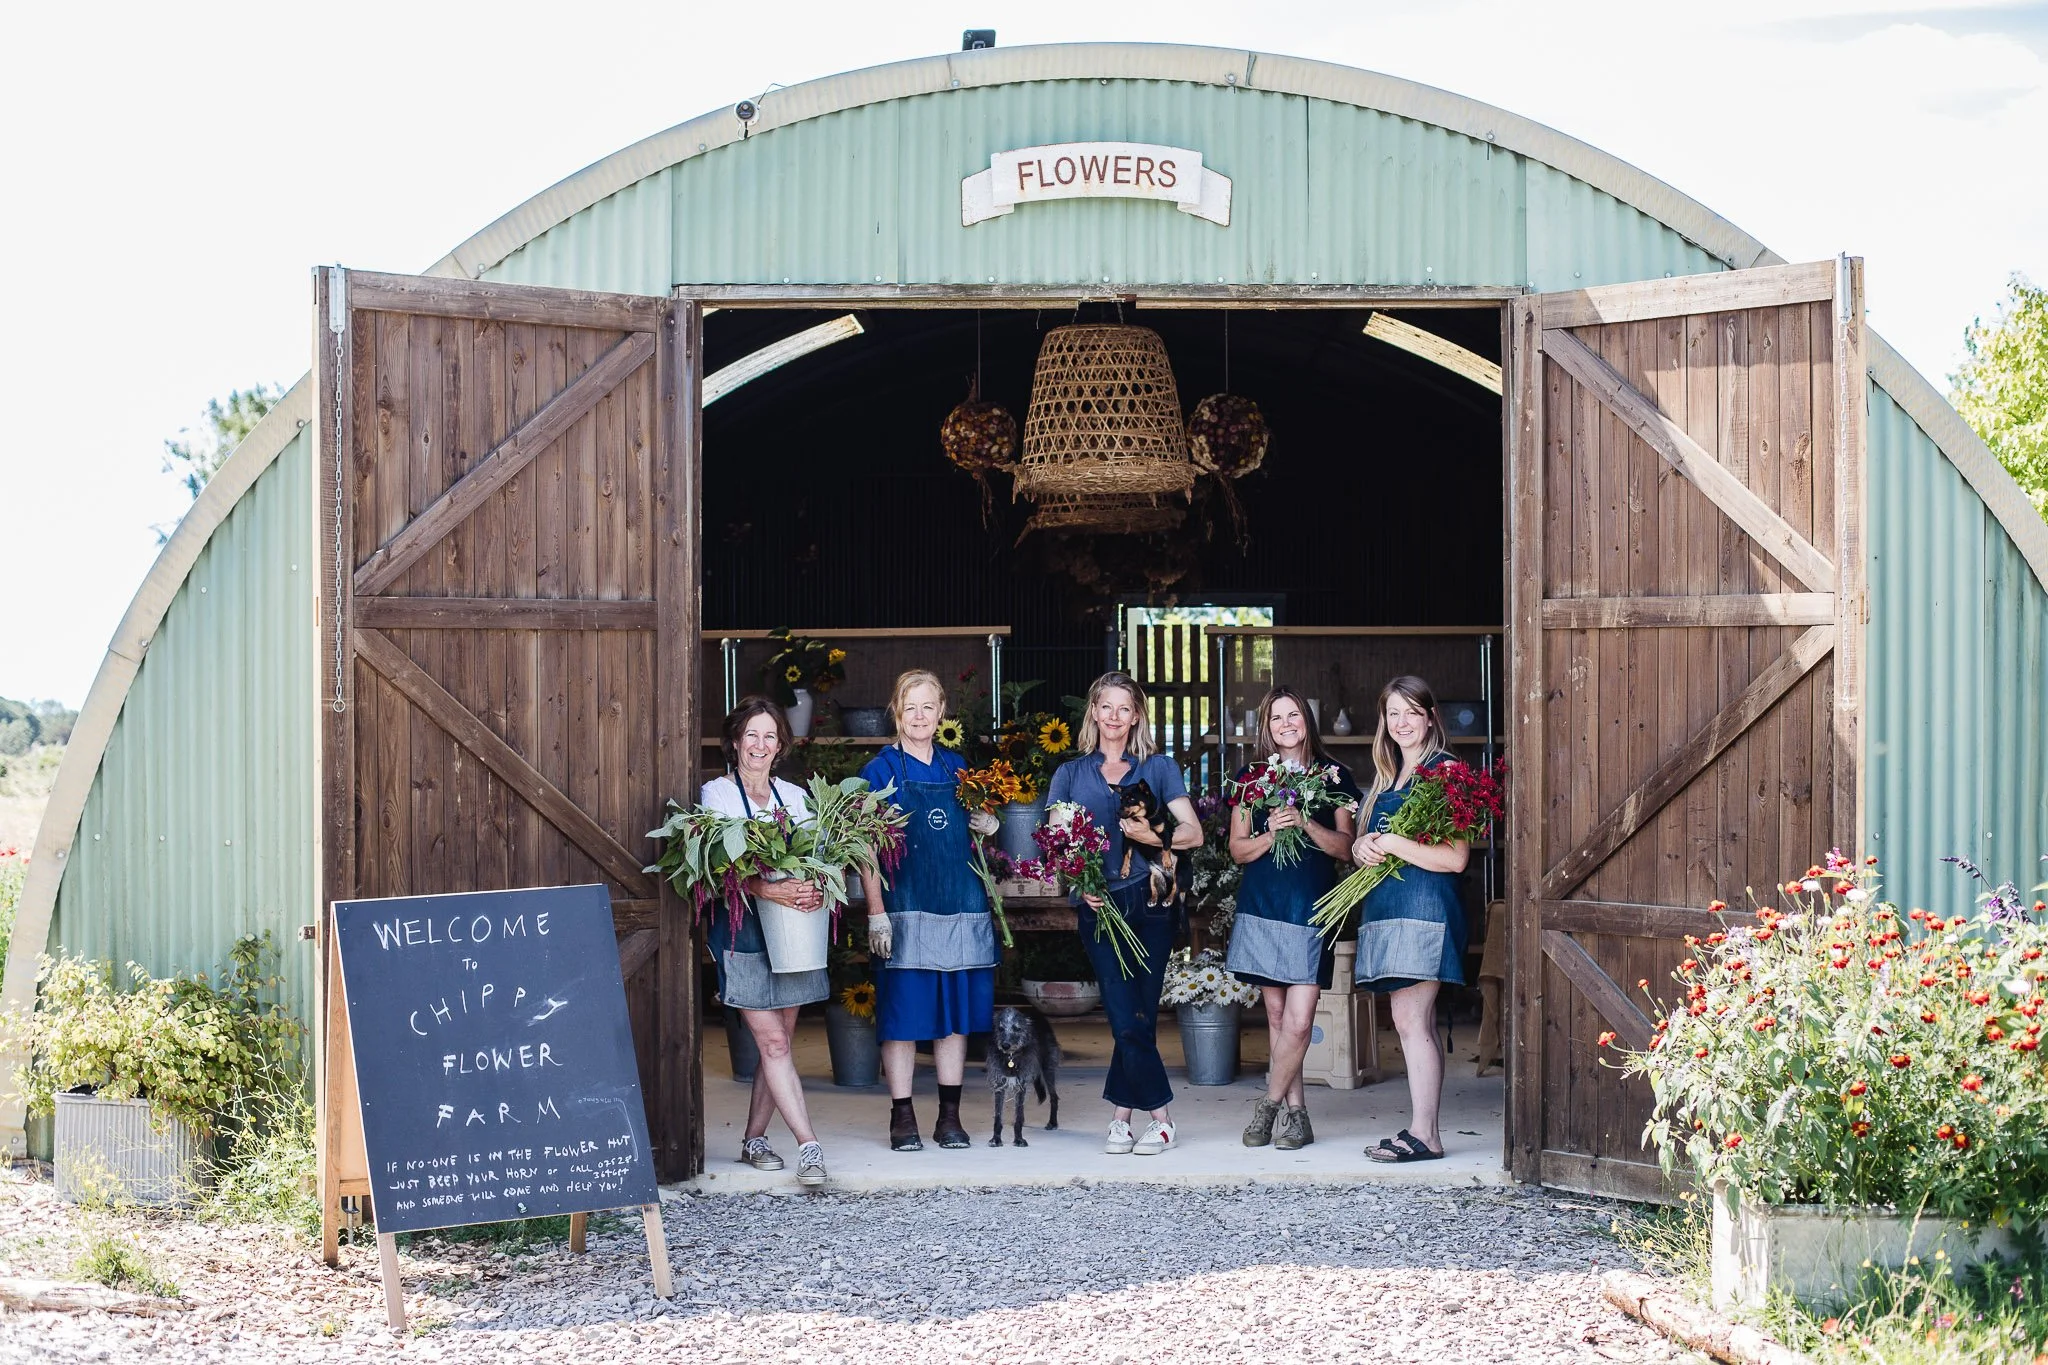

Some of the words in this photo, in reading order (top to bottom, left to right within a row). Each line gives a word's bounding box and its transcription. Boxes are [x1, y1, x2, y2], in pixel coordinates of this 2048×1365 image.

[1017, 155, 1177, 190] FLOWERS
[373, 911, 550, 950] WELCOME
[442, 1042, 563, 1075] FLOWER
[436, 1096, 561, 1128] FARM
[386, 1162, 398, 1173] IF
[406, 1155, 458, 1171] NO-ONE
[468, 1153, 481, 1164] IS
[488, 1150, 503, 1161] IN
[508, 1148, 532, 1160] THE
[544, 1140, 599, 1159] FLOWER
[607, 1134, 631, 1149] HUT
[389, 1179, 420, 1190] JUST
[428, 1173, 459, 1189] BEEP
[466, 1170, 500, 1186] YOUR
[505, 1167, 538, 1180] HORN
[570, 1164, 593, 1173] CALL
[396, 1200, 416, 1211] AND
[469, 1190, 497, 1202] WILL
[503, 1185, 532, 1198] COME
[539, 1182, 560, 1195] AND
[566, 1180, 593, 1193] HELP
